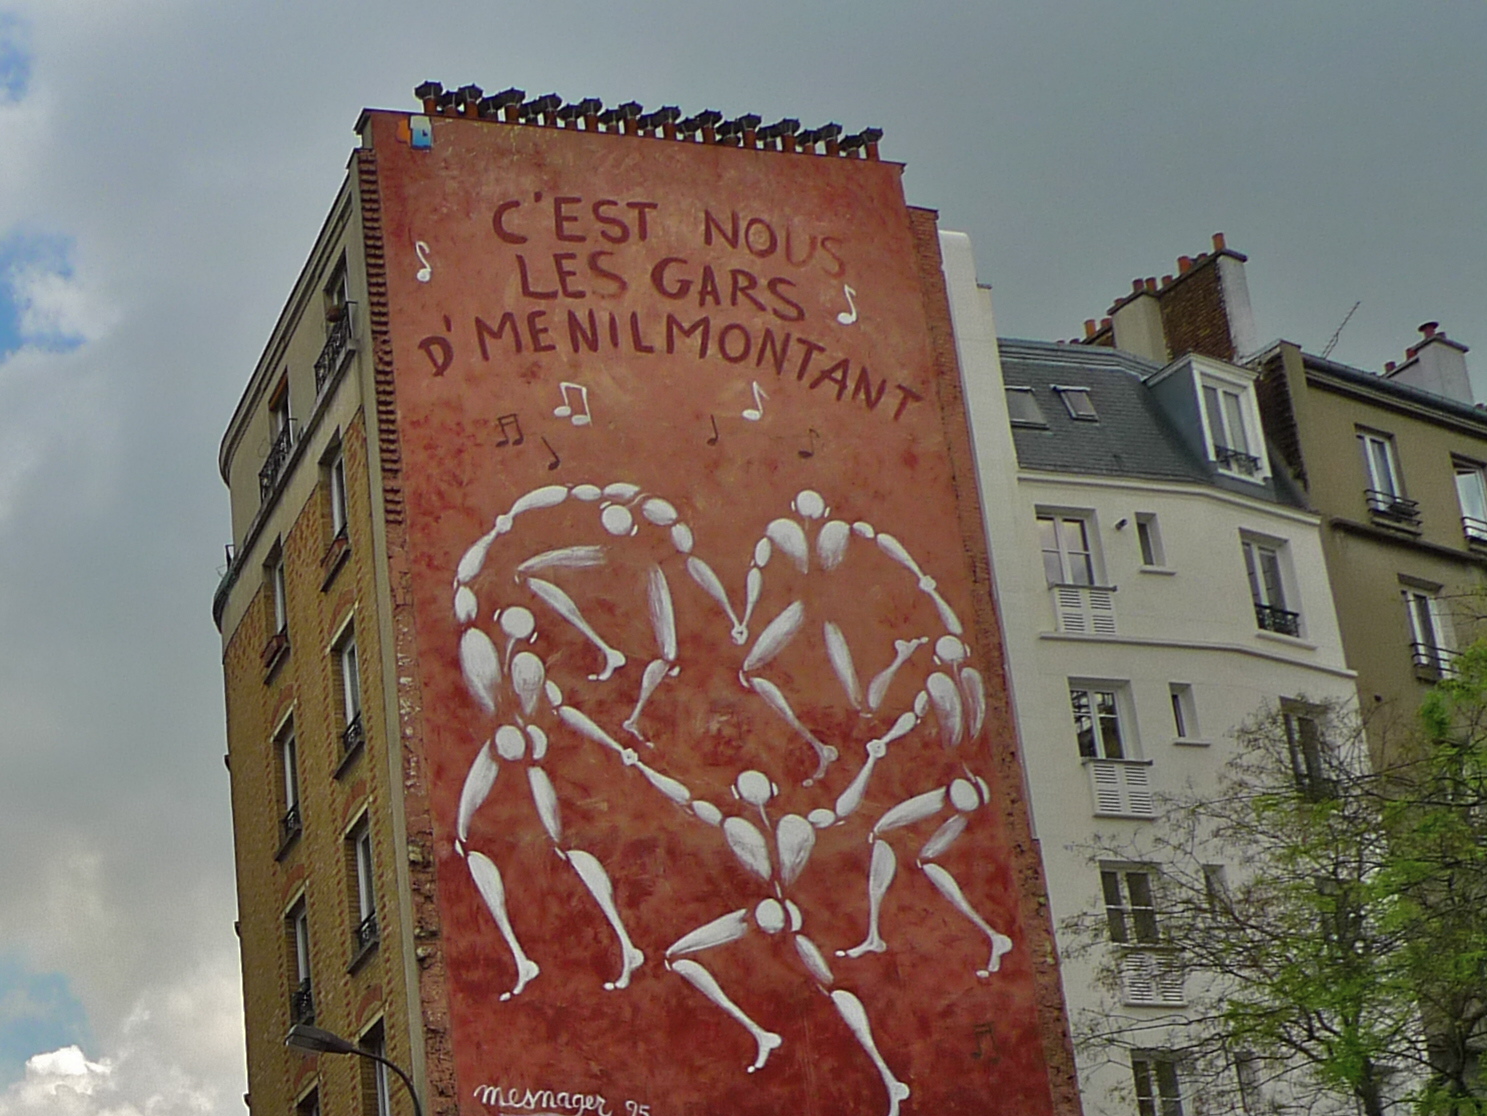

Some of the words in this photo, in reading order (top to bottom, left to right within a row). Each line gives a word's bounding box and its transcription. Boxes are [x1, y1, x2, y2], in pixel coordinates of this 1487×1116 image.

[491, 191, 658, 246] C'EST
[704, 209, 848, 279] NOUS
[516, 251, 628, 302] LES
[650, 256, 807, 323] GARS
